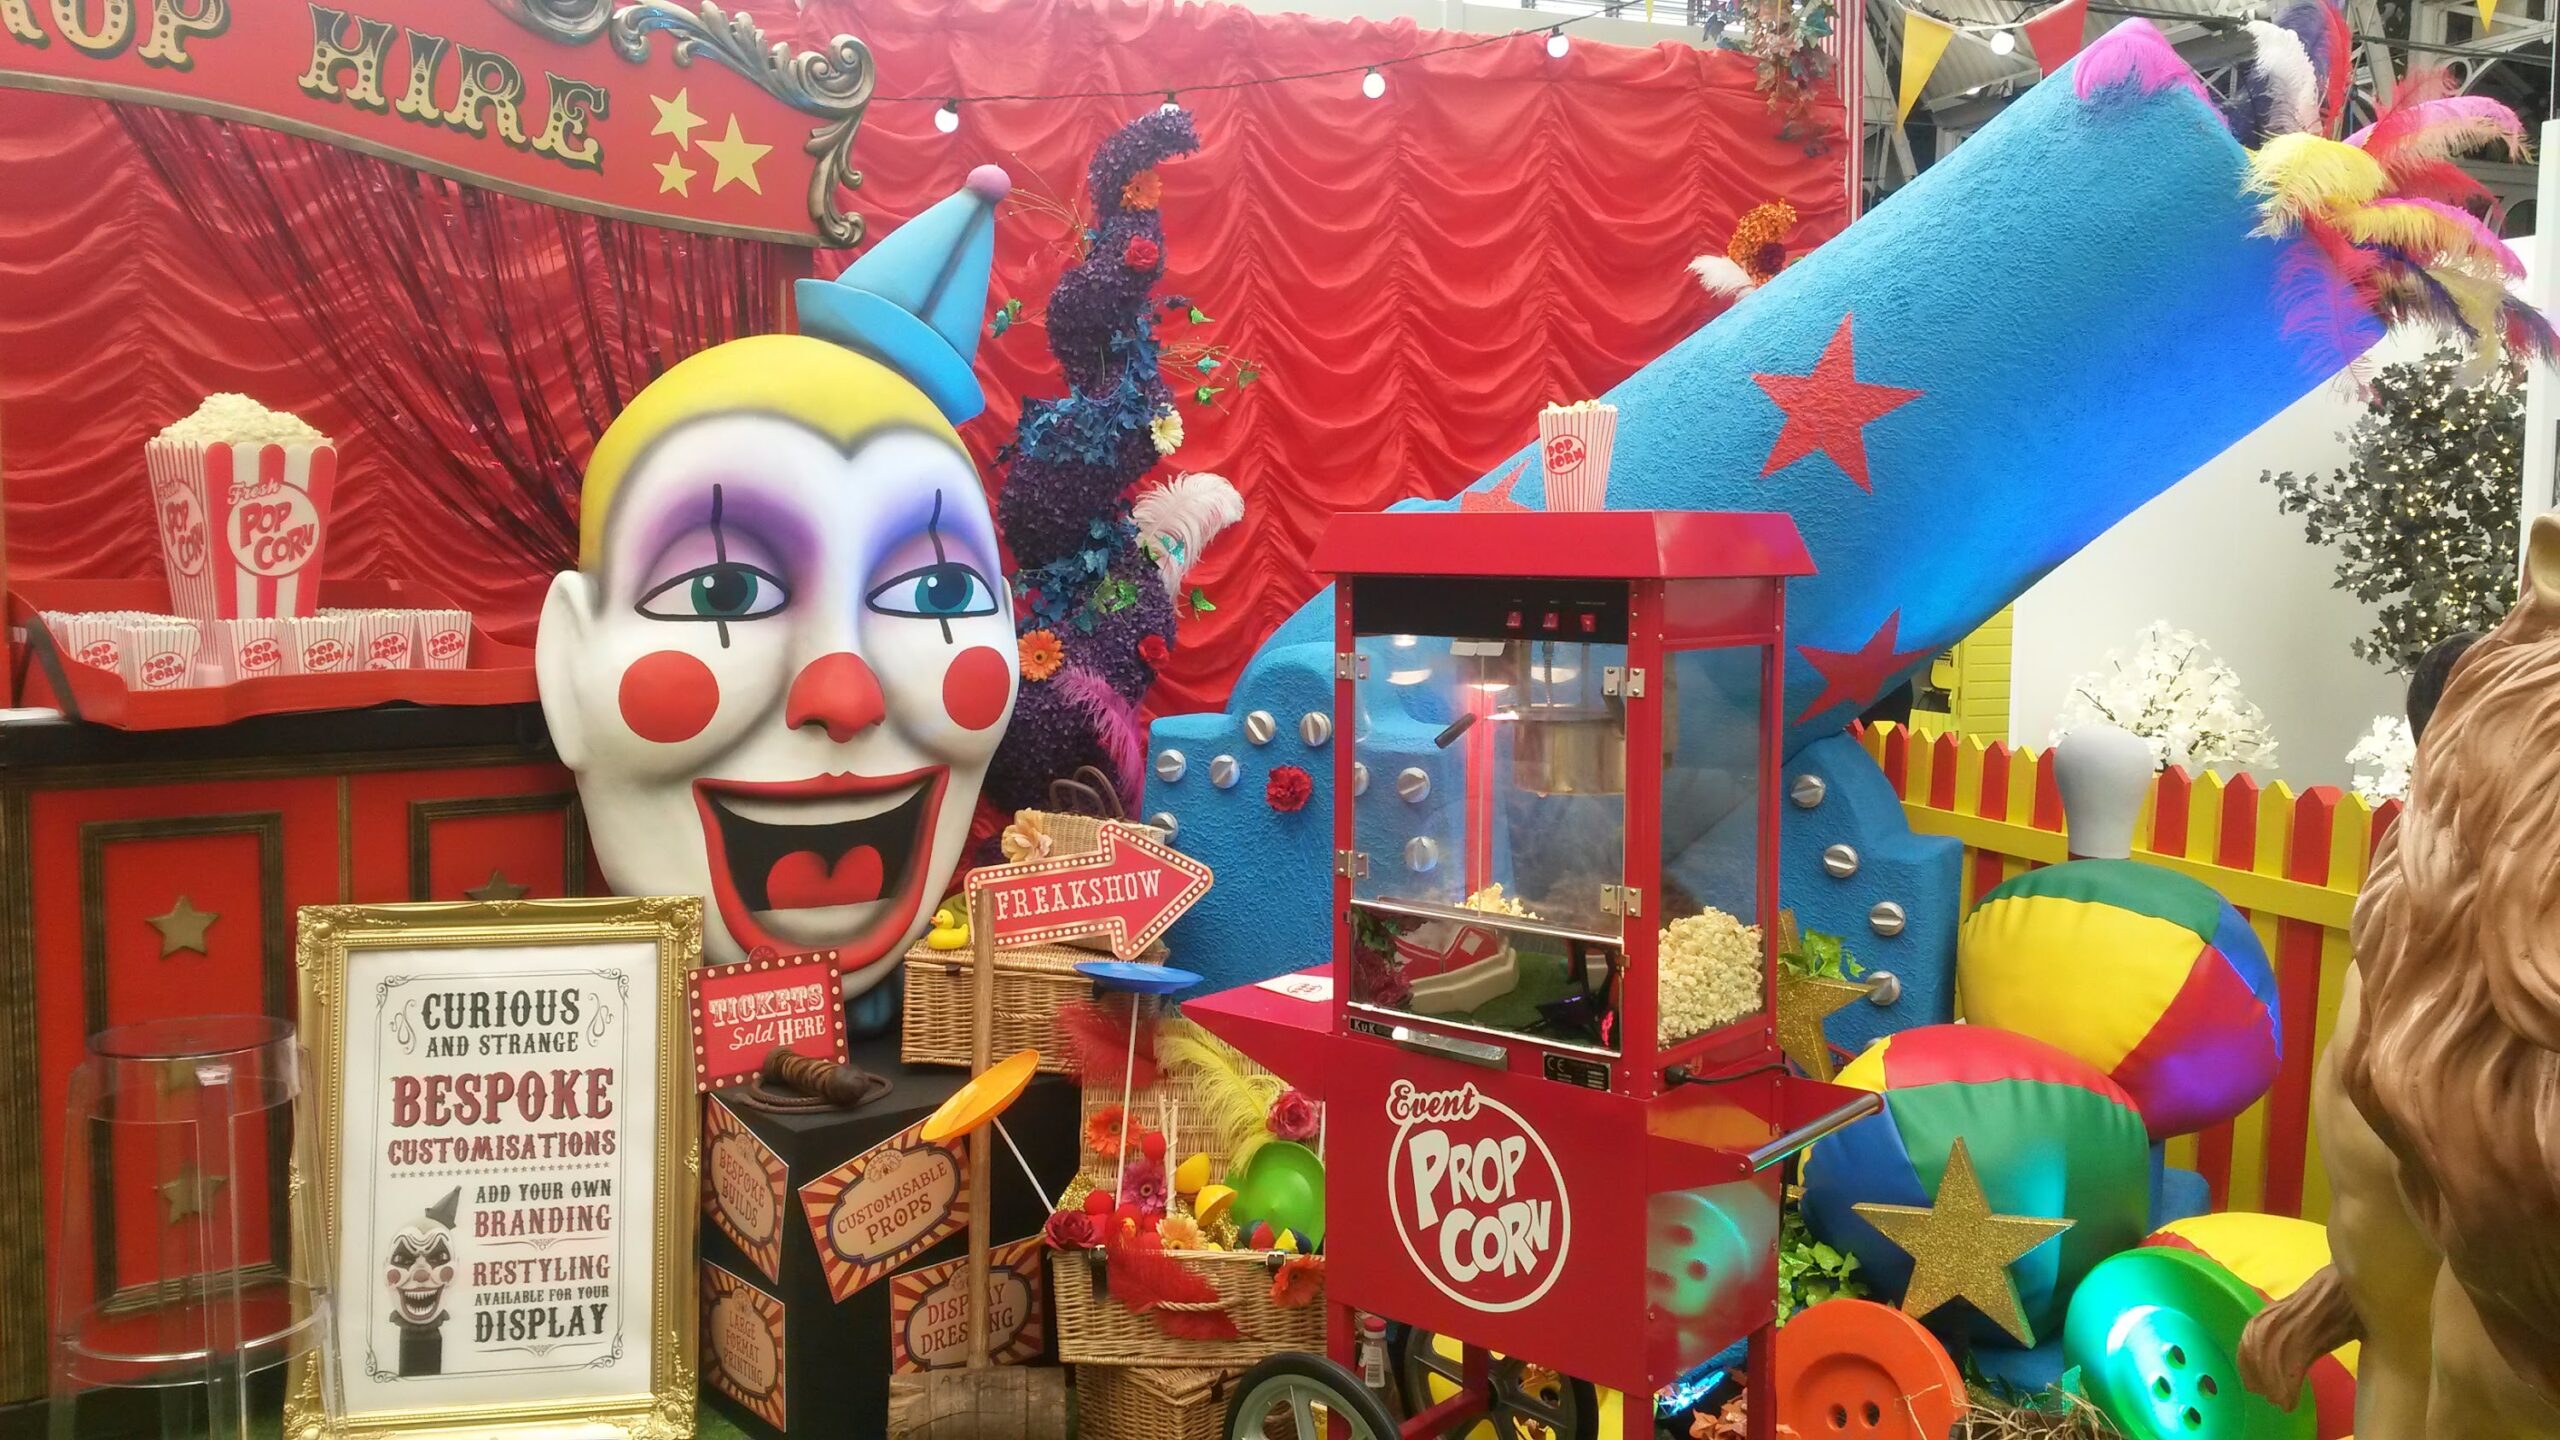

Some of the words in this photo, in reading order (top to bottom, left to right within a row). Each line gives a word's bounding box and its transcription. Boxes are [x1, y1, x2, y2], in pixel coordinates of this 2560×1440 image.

[0, 0, 230, 72] OP
[297, 2, 609, 175] HIRE
[1547, 438, 1574, 458] POP
[1548, 447, 1585, 470] CORN
[227, 477, 281, 505] Fresh
[165, 500, 189, 546] POP
[239, 501, 292, 549] POP
[253, 523, 315, 570] CORN
[82, 643, 111, 659] POP
[244, 641, 271, 657] POP
[308, 642, 334, 657] POP
[374, 635, 398, 650] POP
[431, 633, 456, 647] POP
[432, 640, 465, 656] CORN
[145, 655, 174, 672] POP
[146, 663, 185, 682] CORN
[244, 649, 281, 667] CORN
[308, 650, 343, 667] CORN
[995, 868, 1161, 920] FREAKSHOW
[421, 988, 580, 1030] CURIOUS
[708, 983, 824, 1027] TICKETS
[425, 1036, 469, 1058] AND
[479, 1031, 579, 1056] STRANGE
[729, 1021, 775, 1050] Sold
[777, 1014, 826, 1046] HERE
[390, 1067, 614, 1128] BESPOKE
[1388, 1081, 1478, 1123] Event
[387, 1130, 616, 1166] CUSTOMISATIONS
[475, 1184, 511, 1204] ADD
[519, 1181, 563, 1201] YOUR
[571, 1179, 612, 1198] OWN
[719, 1148, 765, 1208] BESPOKE
[1408, 1129, 1527, 1231] PROP
[721, 1177, 758, 1229] BUILDS
[837, 1161, 948, 1235] CUSTOMISABLE
[474, 1204, 612, 1238] BRANDING
[865, 1193, 932, 1245] PROPS
[1439, 1199, 1552, 1283] CORN
[472, 1254, 611, 1287] RESTYLING
[474, 1289, 544, 1306] AVAILABLE
[548, 1288, 572, 1302] FOR
[577, 1285, 609, 1299] YOUR
[927, 1283, 1006, 1327] DISPY
[474, 1303, 608, 1343] DISPLAY
[729, 1311, 756, 1340] LARGE
[920, 1307, 1014, 1355] DRESNG
[726, 1330, 760, 1364] FORMAT
[724, 1353, 762, 1387] PRINTING
